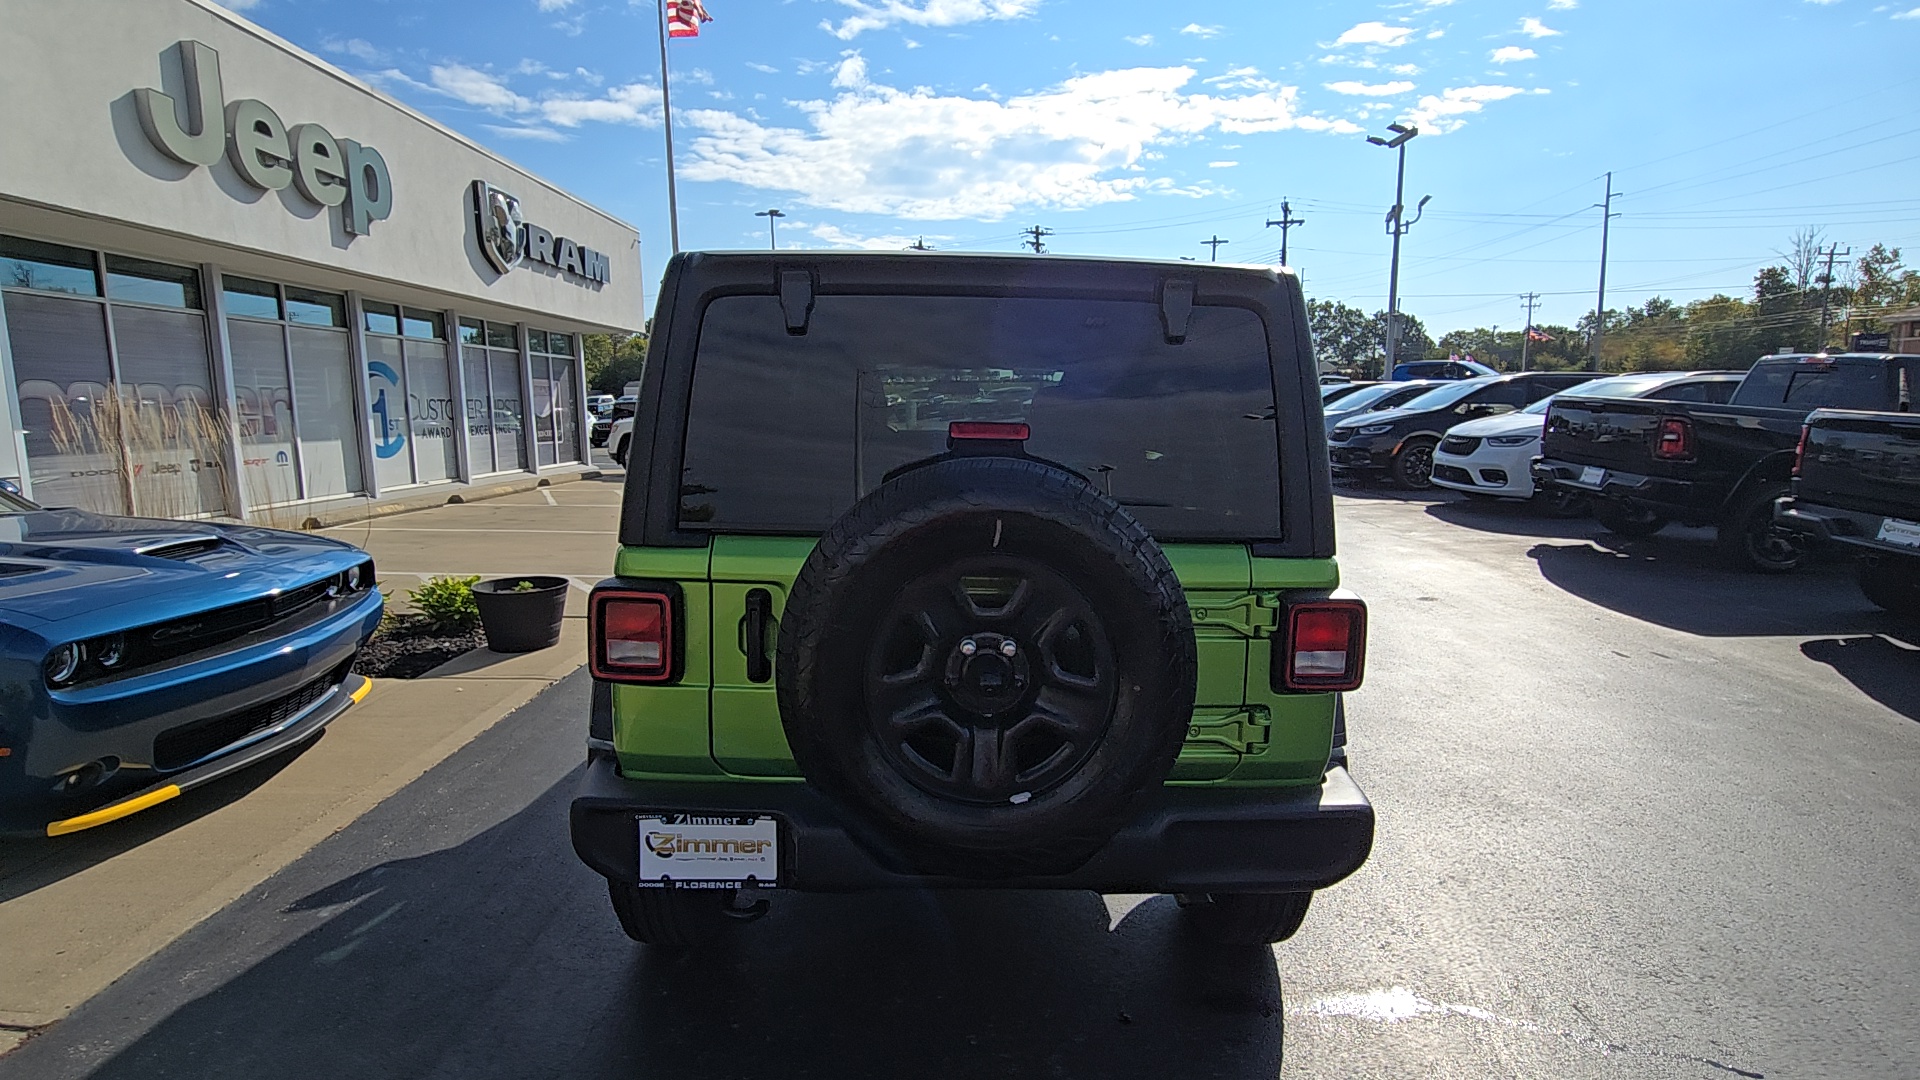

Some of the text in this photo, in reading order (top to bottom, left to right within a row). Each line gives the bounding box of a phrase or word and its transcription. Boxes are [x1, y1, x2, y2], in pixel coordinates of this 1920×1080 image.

[134, 40, 392, 236] Jeep
[526, 222, 610, 285] RAM
[405, 392, 485, 420] CUSTOER
[422, 426, 451, 439] AWARD
[71, 468, 120, 478] DODG
[152, 461, 181, 476] Jeep
[673, 813, 741, 826] Zimmer
[653, 833, 772, 855] Zimmer
[675, 881, 742, 889] FLORENCE
